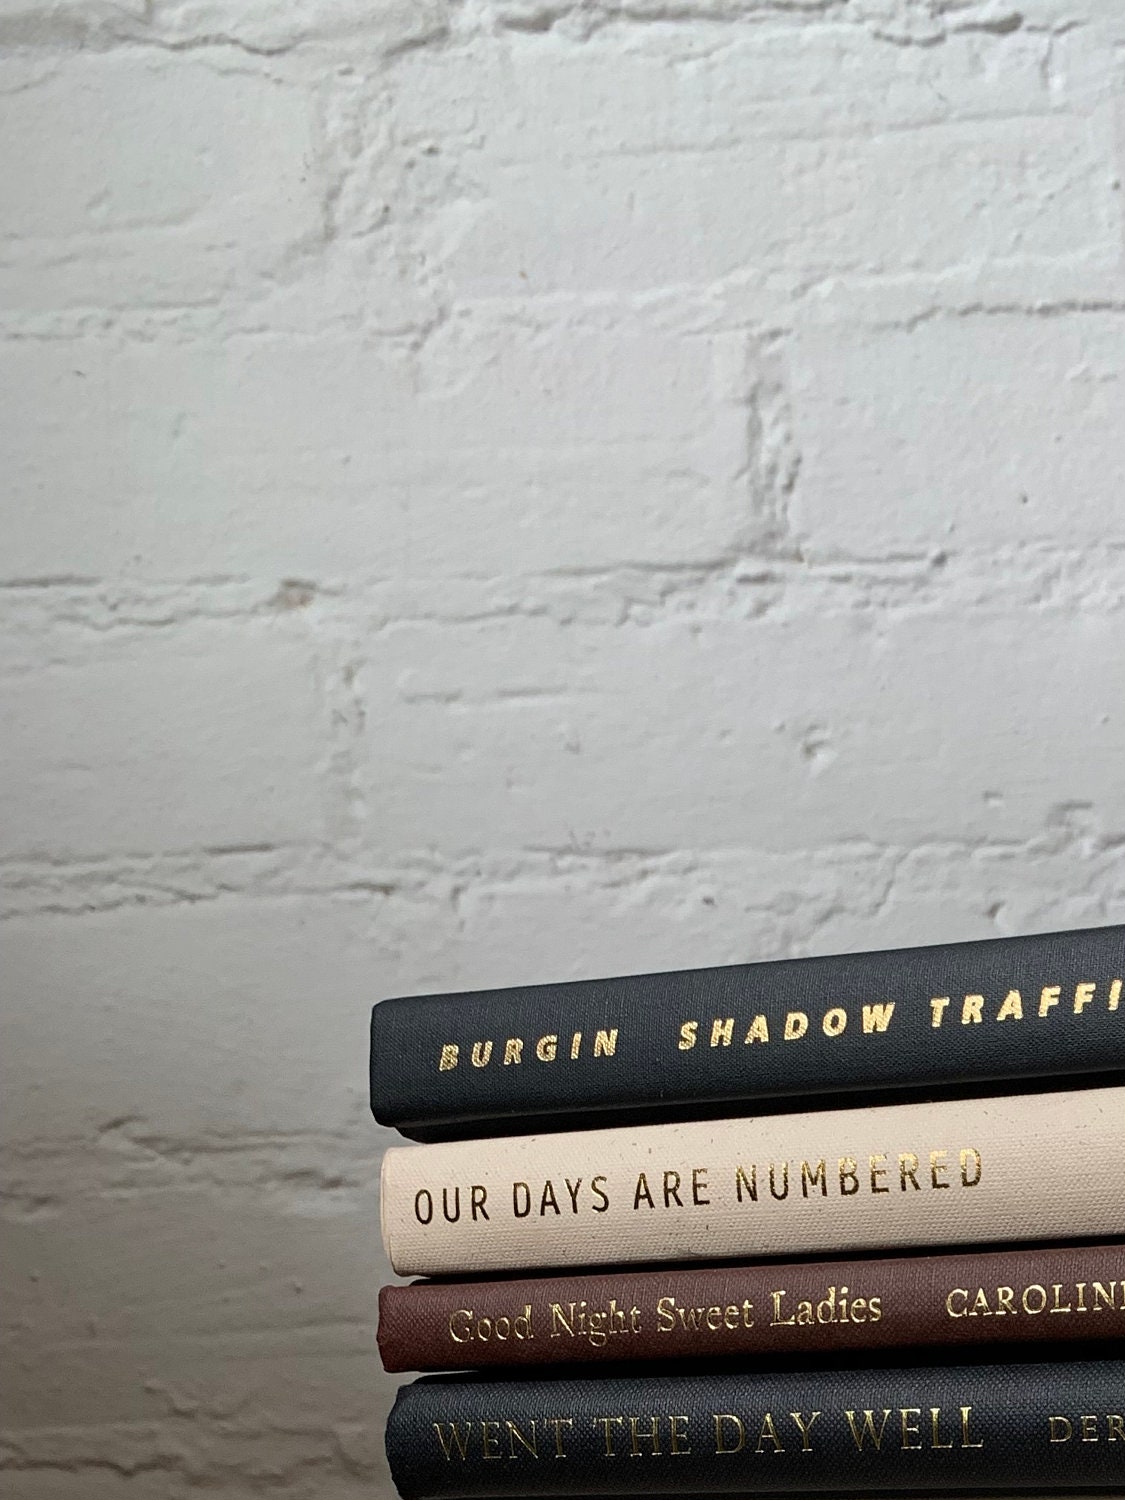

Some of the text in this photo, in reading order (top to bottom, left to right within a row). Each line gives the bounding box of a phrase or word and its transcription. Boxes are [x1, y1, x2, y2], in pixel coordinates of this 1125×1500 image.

[439, 1029, 622, 1072] BURGIN
[677, 1002, 897, 1052] SHADOW
[413, 1146, 984, 1226] OUR DAYS ARE NUMBERED
[448, 1284, 883, 1347] Good Night Sweet Ladies
[433, 1406, 985, 1460] WENT THE DAY WELL
